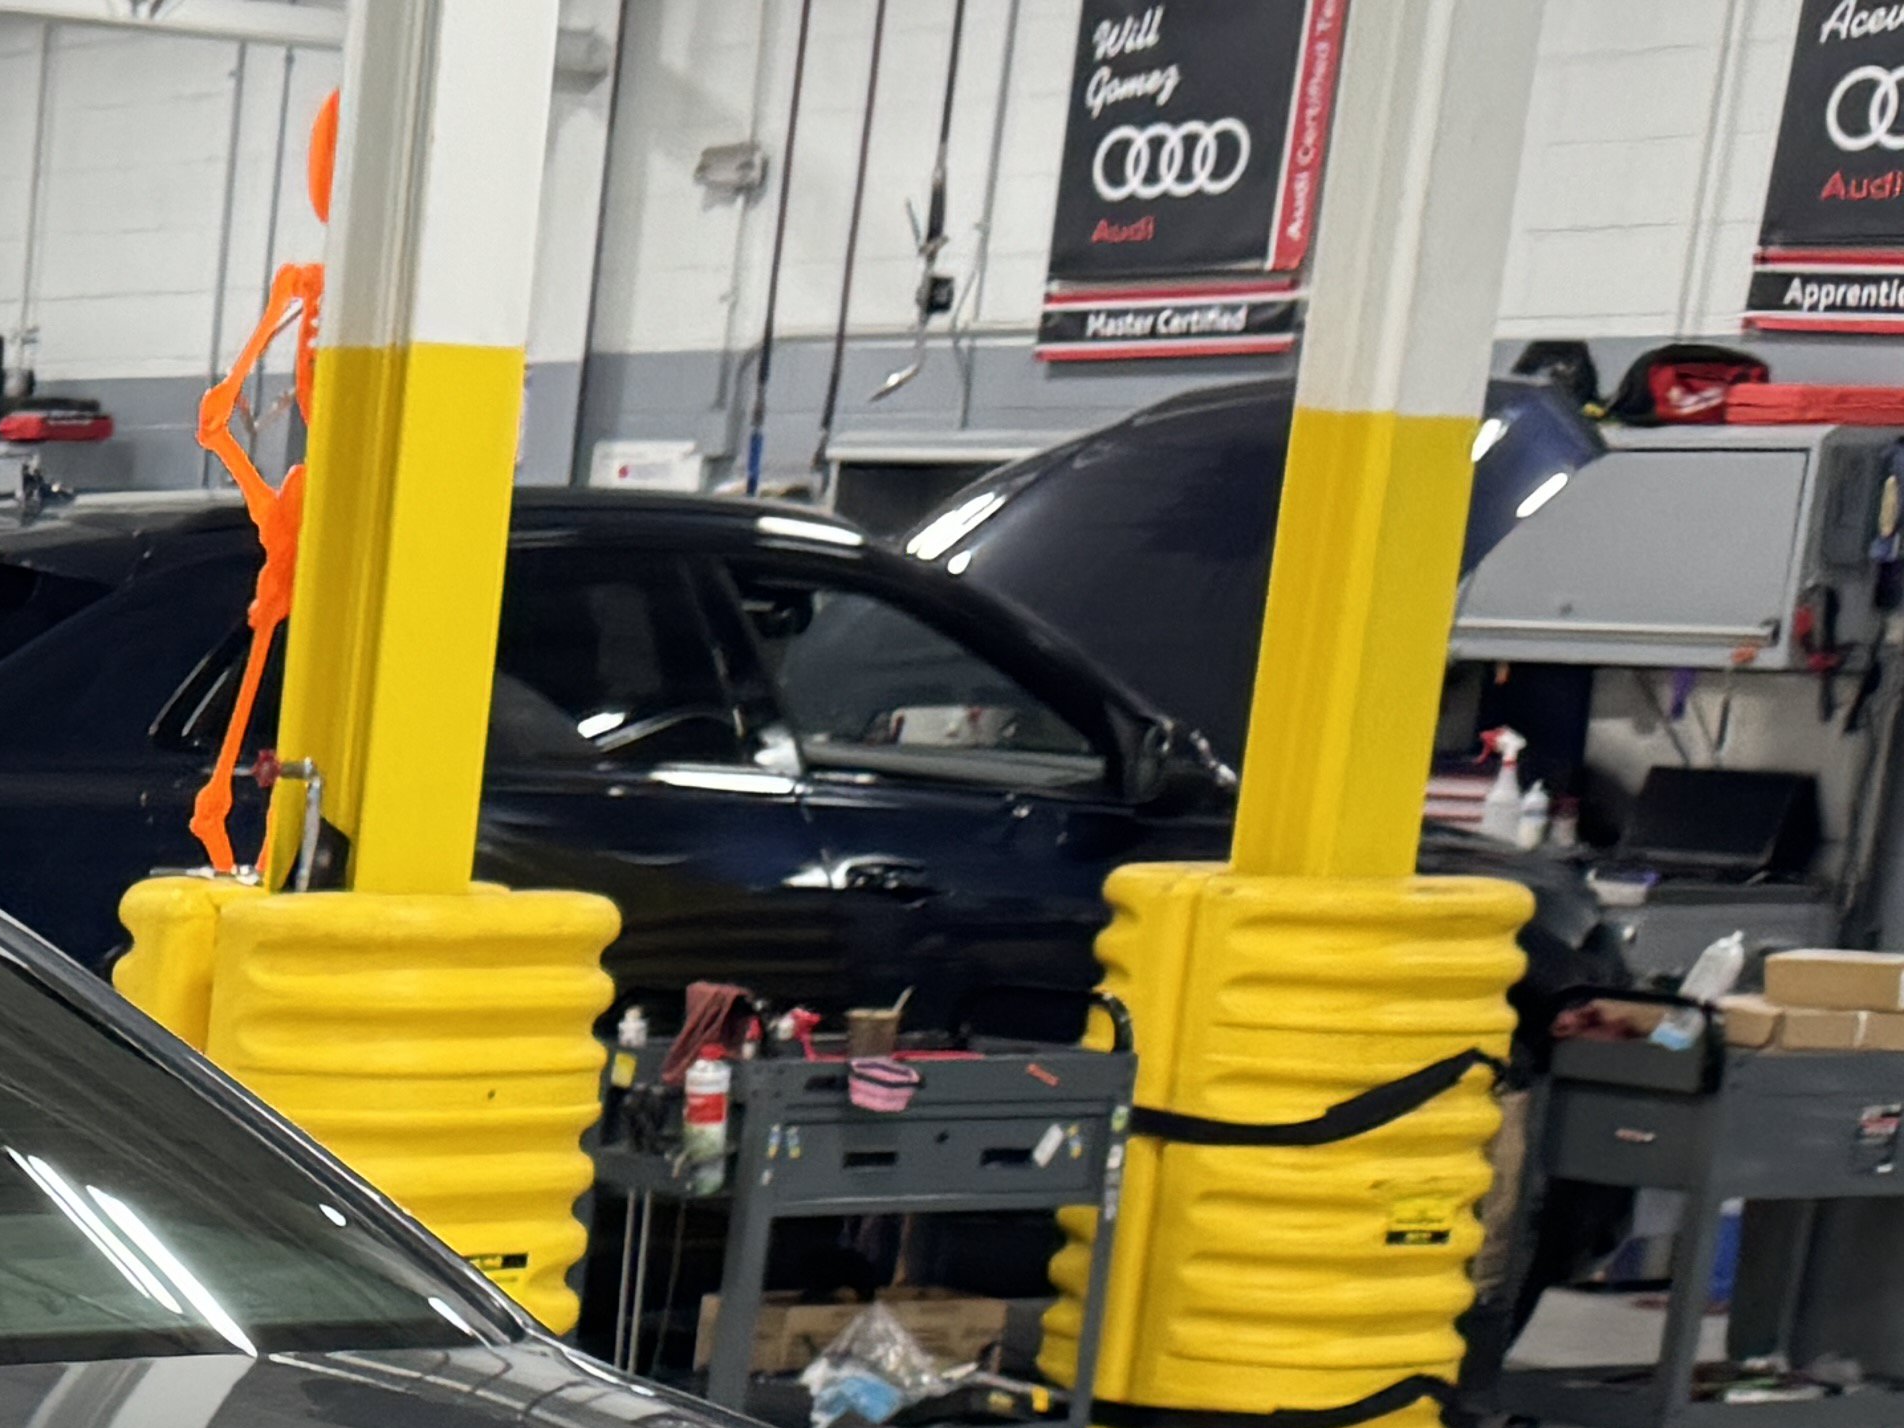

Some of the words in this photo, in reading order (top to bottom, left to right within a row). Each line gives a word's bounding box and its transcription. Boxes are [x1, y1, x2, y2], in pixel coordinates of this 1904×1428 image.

[1093, 4, 1164, 61] Will
[1085, 63, 1180, 119] Gomez
[1296, 41, 1330, 165] Certified
[1287, 171, 1310, 241] Audi
[1820, 170, 1904, 200] Audi
[1091, 214, 1156, 243] Audi
[1086, 312, 1154, 338] Master
[1155, 304, 1249, 335] Certified
